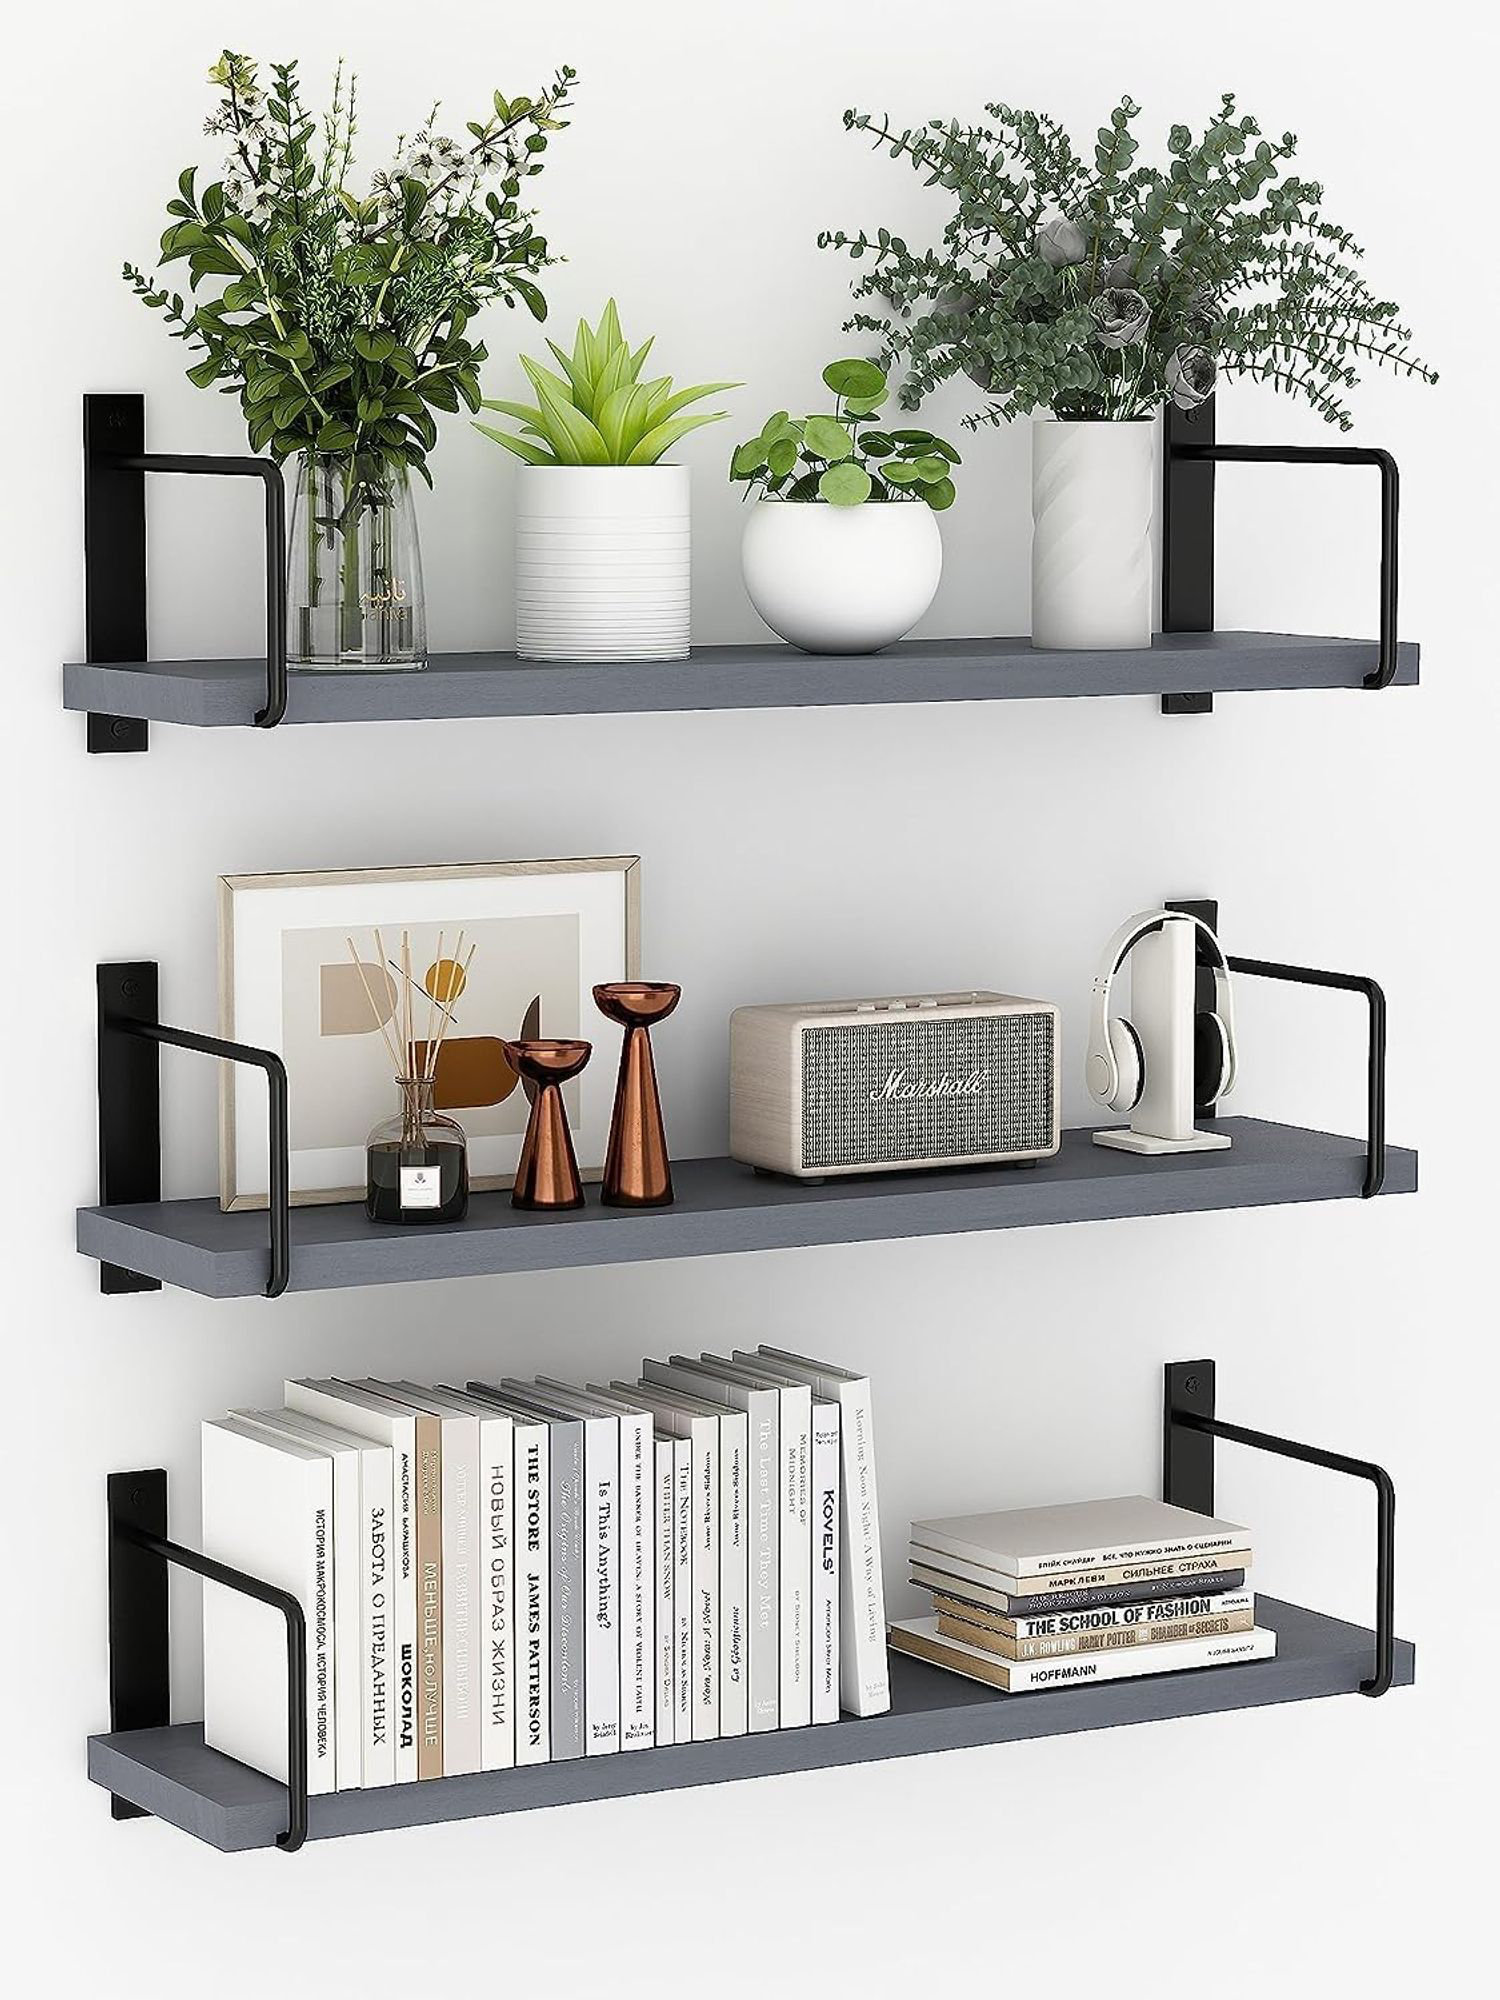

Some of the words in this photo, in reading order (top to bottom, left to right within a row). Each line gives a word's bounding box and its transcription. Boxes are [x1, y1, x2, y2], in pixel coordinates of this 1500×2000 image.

[869, 1067, 989, 1100] Marshall
[759, 1418, 772, 1451] The
[855, 1408, 867, 1462] Morning
[401, 1452, 410, 1514] АНАСТАСИЯ
[528, 1444, 540, 1484] THE
[680, 1462, 690, 1492] THE
[759, 1457, 771, 1496] Last
[788, 1447, 796, 1515] MIDNIGHT
[799, 1433, 807, 1506] MEMORIES
[859, 1464, 869, 1498] Noon
[491, 1465, 507, 1550] НОВЫЙ
[560, 1480, 572, 1511] The
[598, 1481, 611, 1498] Is
[315, 1509, 326, 1559] ИСТОРИЯ
[528, 1489, 541, 1552] STORE
[555, 1511, 572, 1562] Origins
[598, 1502, 611, 1540] This
[680, 1496, 690, 1566] NOTEBOOK
[759, 1499, 772, 1542] Time
[799, 1508, 807, 1527] OF
[822, 1489, 836, 1576] KOVELS'
[371, 1507, 386, 1586] ЗАБОТА
[1186, 1543, 1194, 1551] О
[556, 1566, 573, 1583] of
[596, 1544, 612, 1629] Anything?
[663, 1564, 671, 1600] SNOW
[758, 1547, 772, 1590] They
[1048, 1576, 1078, 1588] МАРК
[1077, 1574, 1106, 1585] ЛЕВИ
[1122, 1564, 1175, 1580] СИЛЬНЕЕ
[1178, 1559, 1218, 1573] СТРАХА
[372, 1593, 386, 1608] О
[491, 1558, 505, 1631] ОБРАЗ
[527, 1571, 541, 1634] JAMES
[759, 1594, 771, 1630] Met
[868, 1602, 878, 1643] Living
[1026, 1618, 1057, 1637] THE
[1059, 1610, 1120, 1632] SCHOOL
[1123, 1607, 1144, 1624] OF
[1146, 1598, 1212, 1621] FASHION
[1078, 1632, 1106, 1651] HARRY
[1106, 1628, 1137, 1647] POTTER
[1150, 1622, 1188, 1641] CHAMBER
[1196, 1617, 1229, 1635] SECRETS
[316, 1653, 327, 1701] ИСТОРИЯ
[371, 1614, 387, 1747] ПРЕДАННЫХ
[491, 1639, 505, 1726] ЖИЗНИ
[528, 1639, 541, 1746] PATTERSON
[1029, 1664, 1098, 1683] HOFFMANN
[399, 1642, 414, 1749] ШОКОЛАД
[423, 1679, 439, 1748] ЛУЧШЕ
[317, 1703, 327, 1758] ЧЕЛОВЕКА
